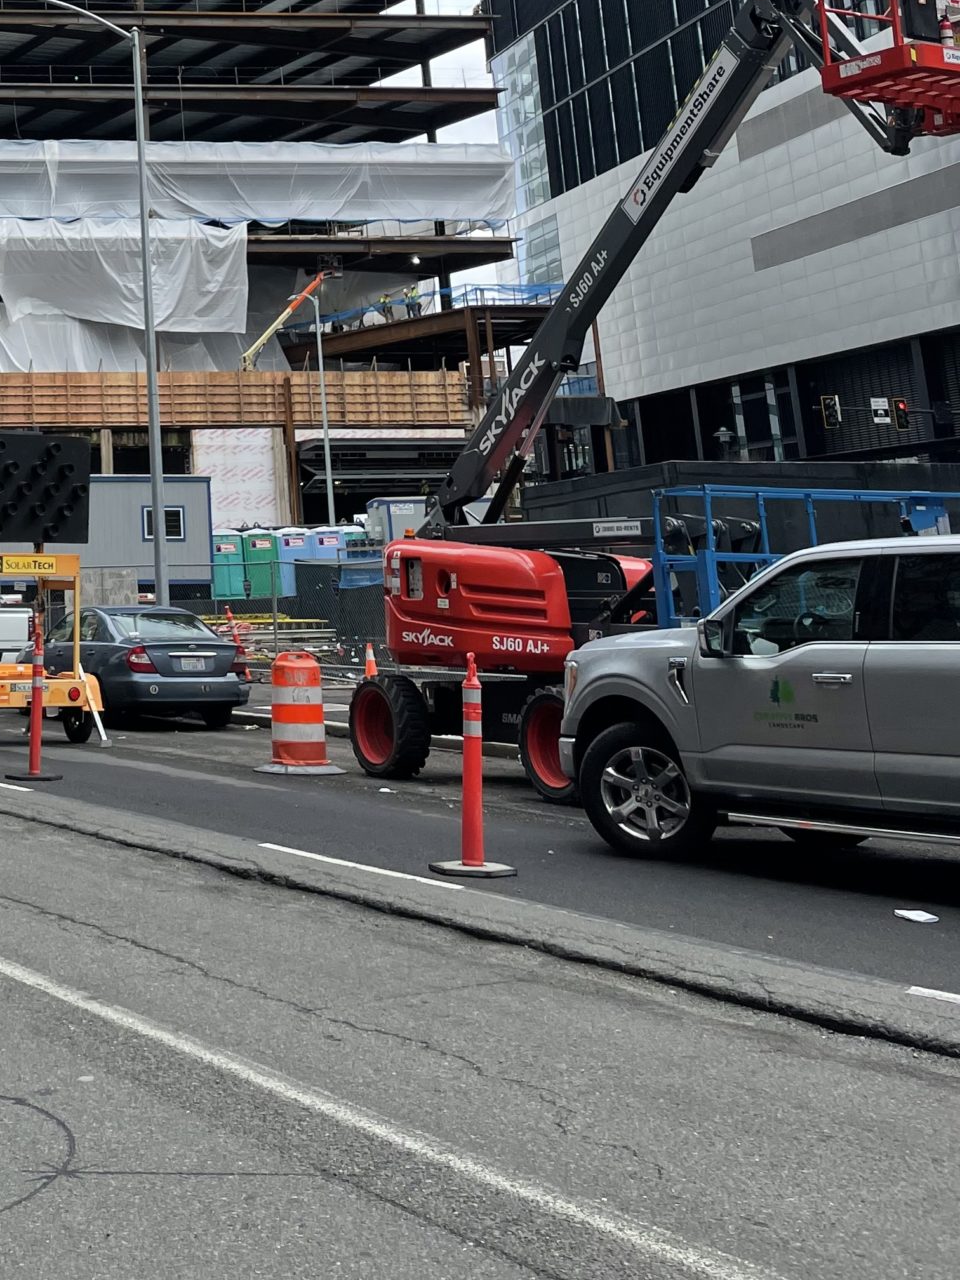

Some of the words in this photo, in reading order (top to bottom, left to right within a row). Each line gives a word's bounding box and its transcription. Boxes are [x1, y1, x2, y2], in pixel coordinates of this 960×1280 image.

[642, 65, 726, 191] EquipmentShare
[569, 272, 594, 308] SJ60
[591, 249, 609, 278] AJ+
[479, 351, 546, 456] SKYJACK
[402, 627, 454, 647] SKYJACK
[492, 635, 523, 652] SJ60
[526, 639, 550, 654] AJ+
[501, 712, 523, 724] SMA
[794, 713, 819, 723] BROS
